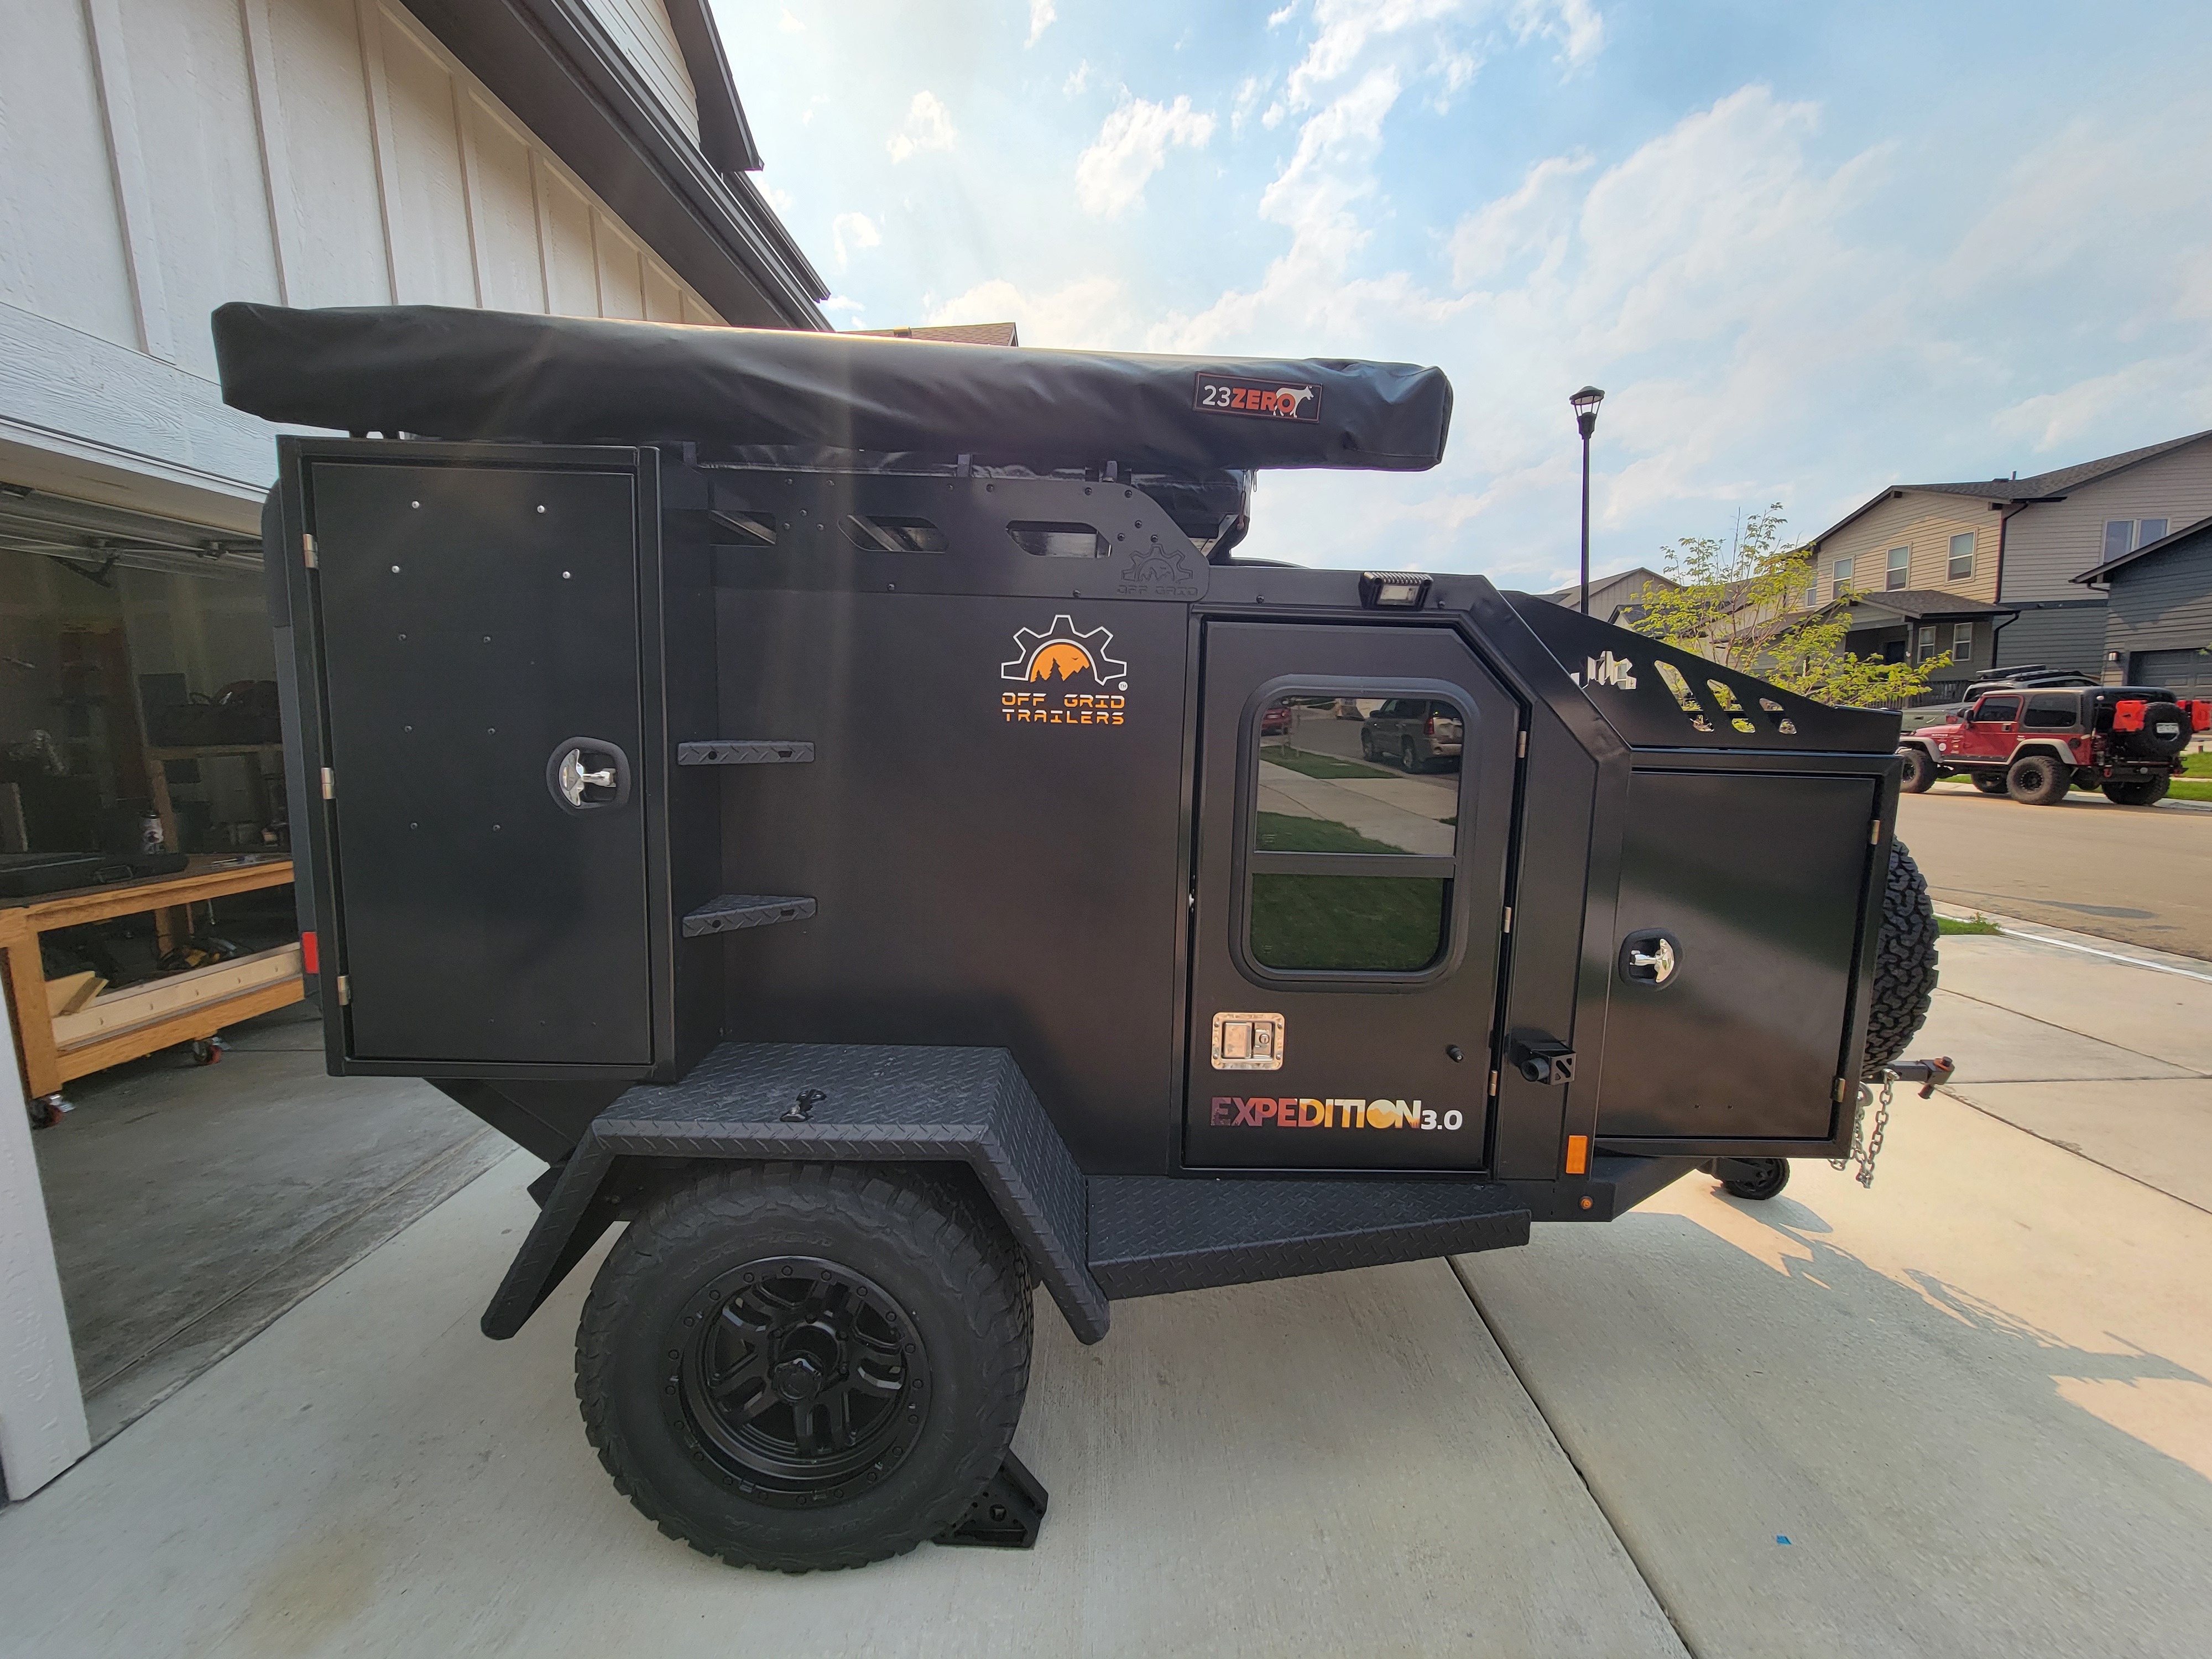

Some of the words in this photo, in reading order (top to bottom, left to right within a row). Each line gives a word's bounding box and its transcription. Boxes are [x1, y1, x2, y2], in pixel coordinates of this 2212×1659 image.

[1202, 384, 1296, 413] 23ZERO
[1001, 692, 1047, 706] OFF
[1064, 693, 1125, 708] GRID
[1001, 709, 1125, 725] TRAILERS
